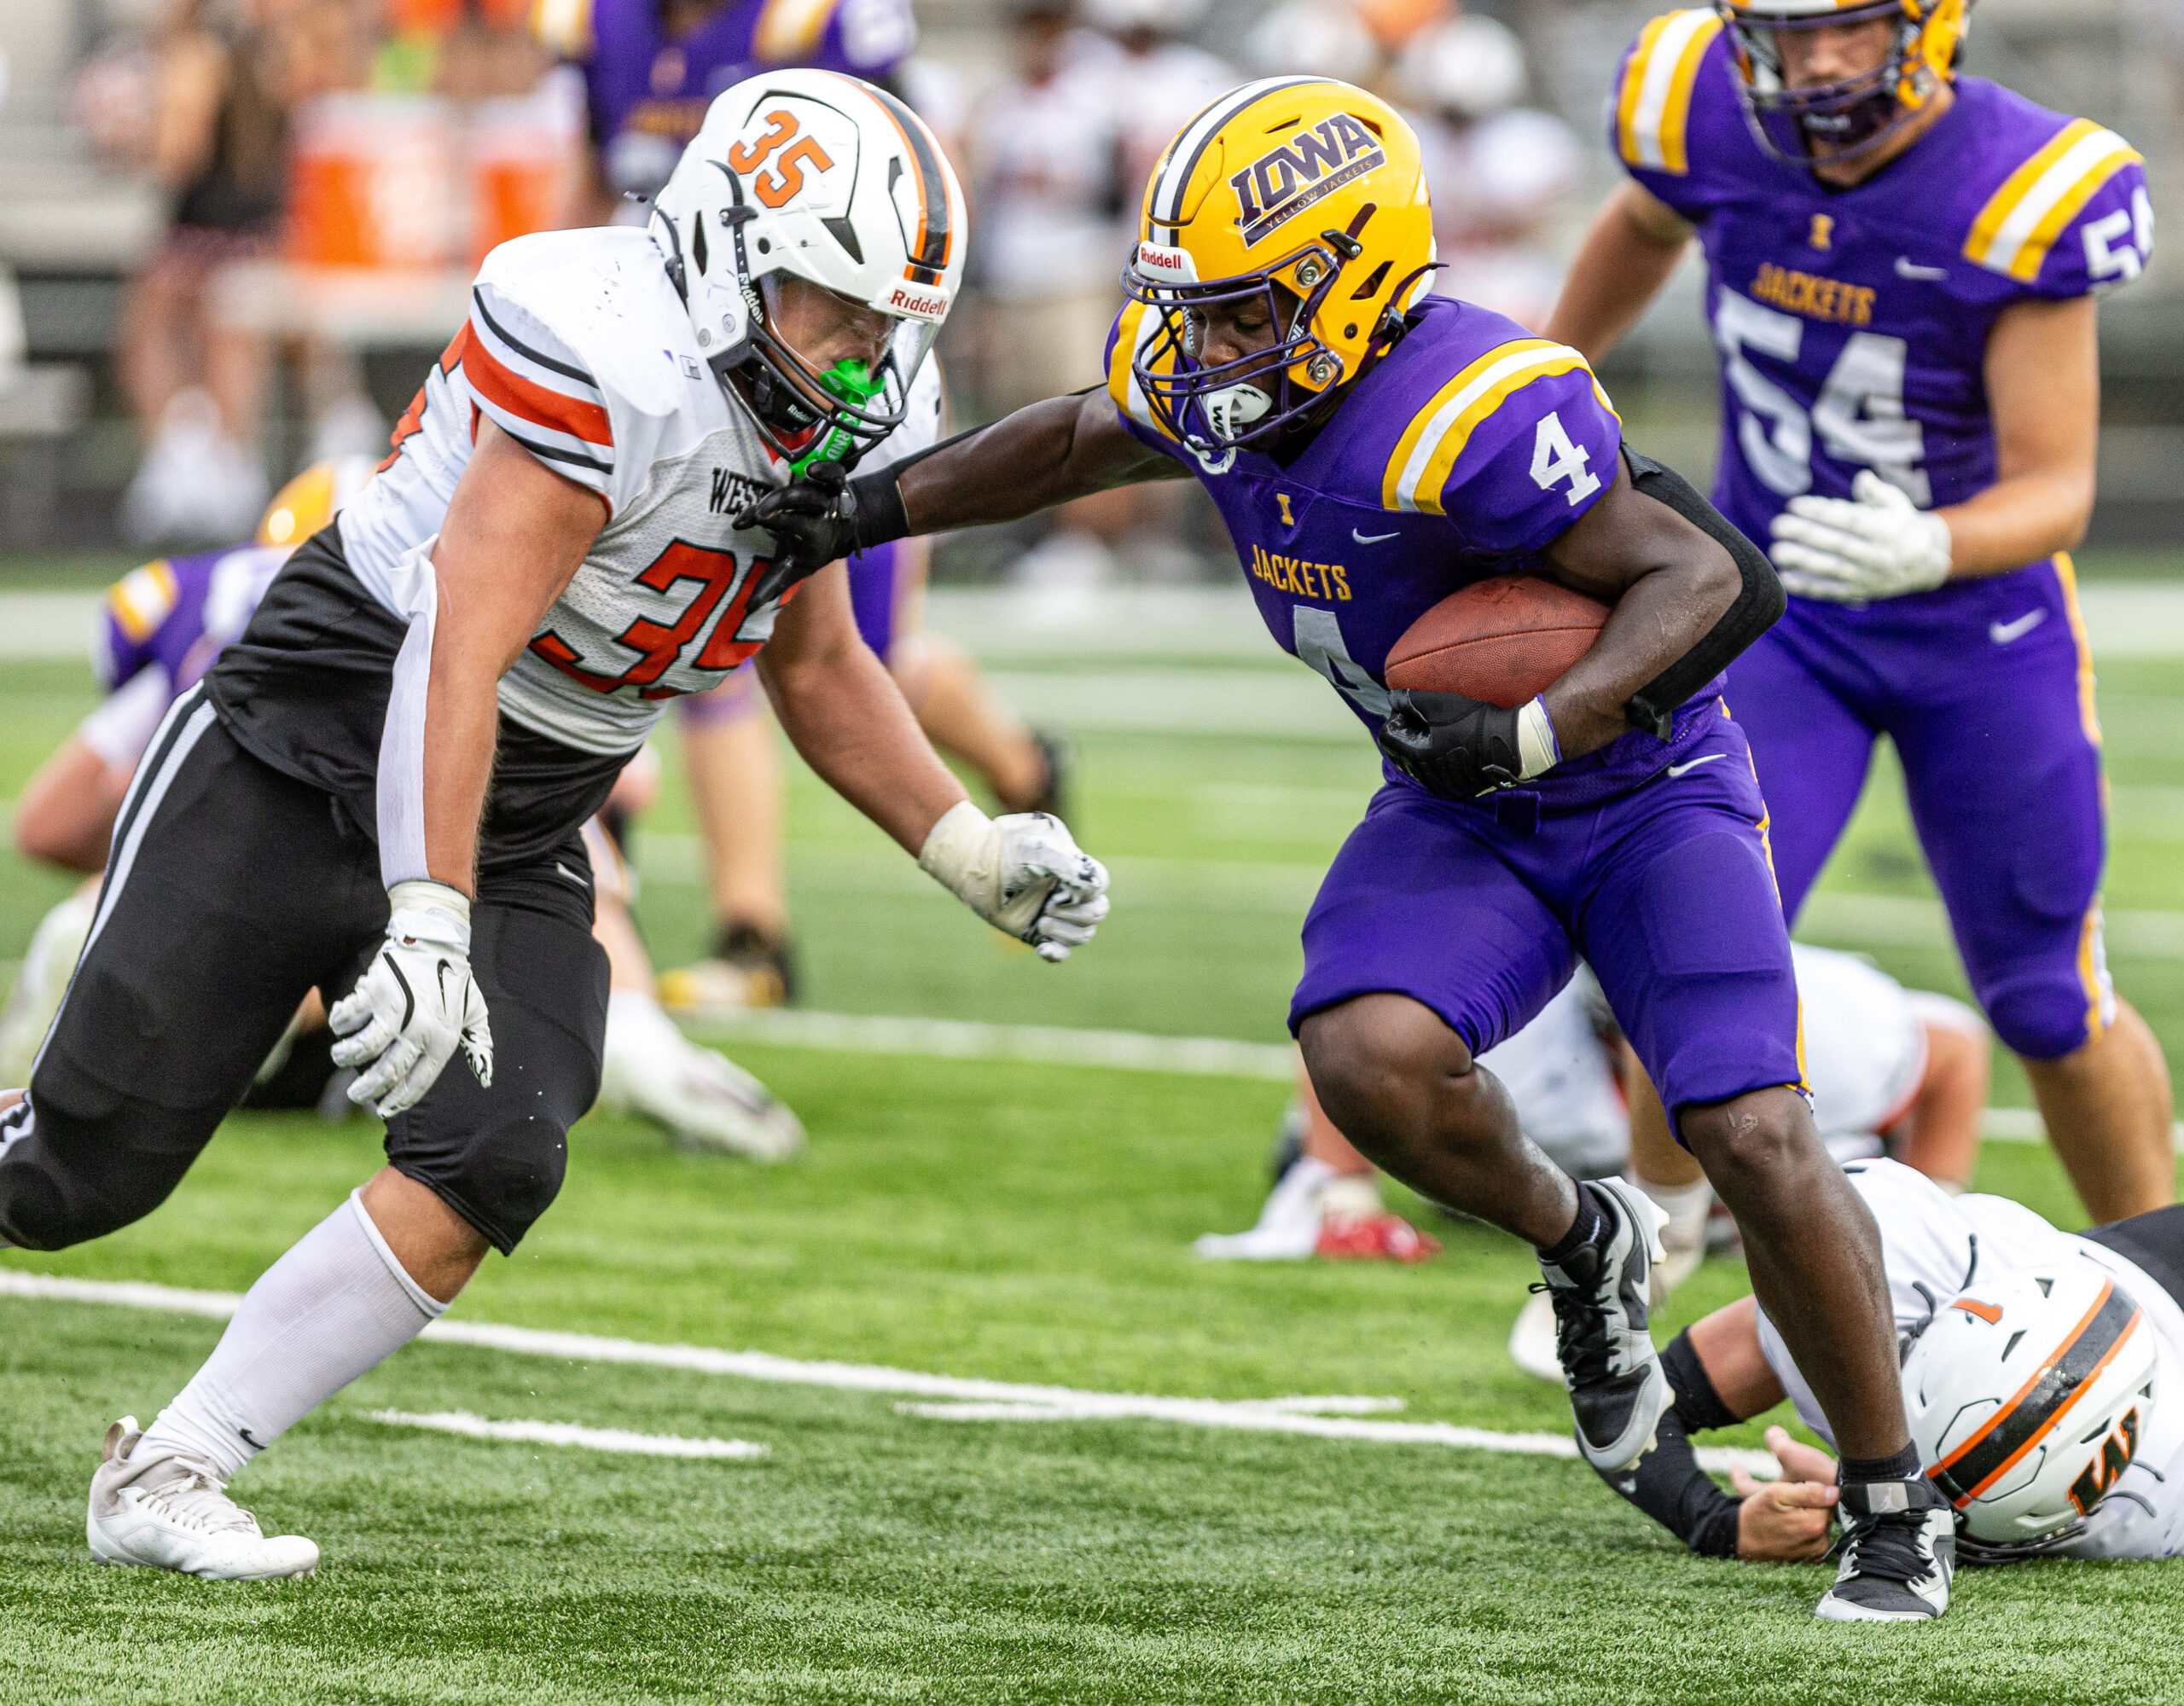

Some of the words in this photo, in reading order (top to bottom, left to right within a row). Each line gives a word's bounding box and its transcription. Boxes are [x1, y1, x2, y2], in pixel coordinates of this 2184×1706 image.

[729, 109, 835, 208] 35
[1229, 113, 1380, 229] IOWA
[1266, 190, 1319, 229] YELLOW
[1323, 160, 1373, 193] JACKETS
[1141, 247, 1182, 270] Riddell
[1750, 261, 1876, 328] JACKETS
[890, 289, 948, 316] Riddell
[1716, 283, 1932, 509] 54
[1529, 410, 1602, 507] 4
[1252, 543, 1353, 601] JACKETS
[1293, 604, 1394, 720] 4
